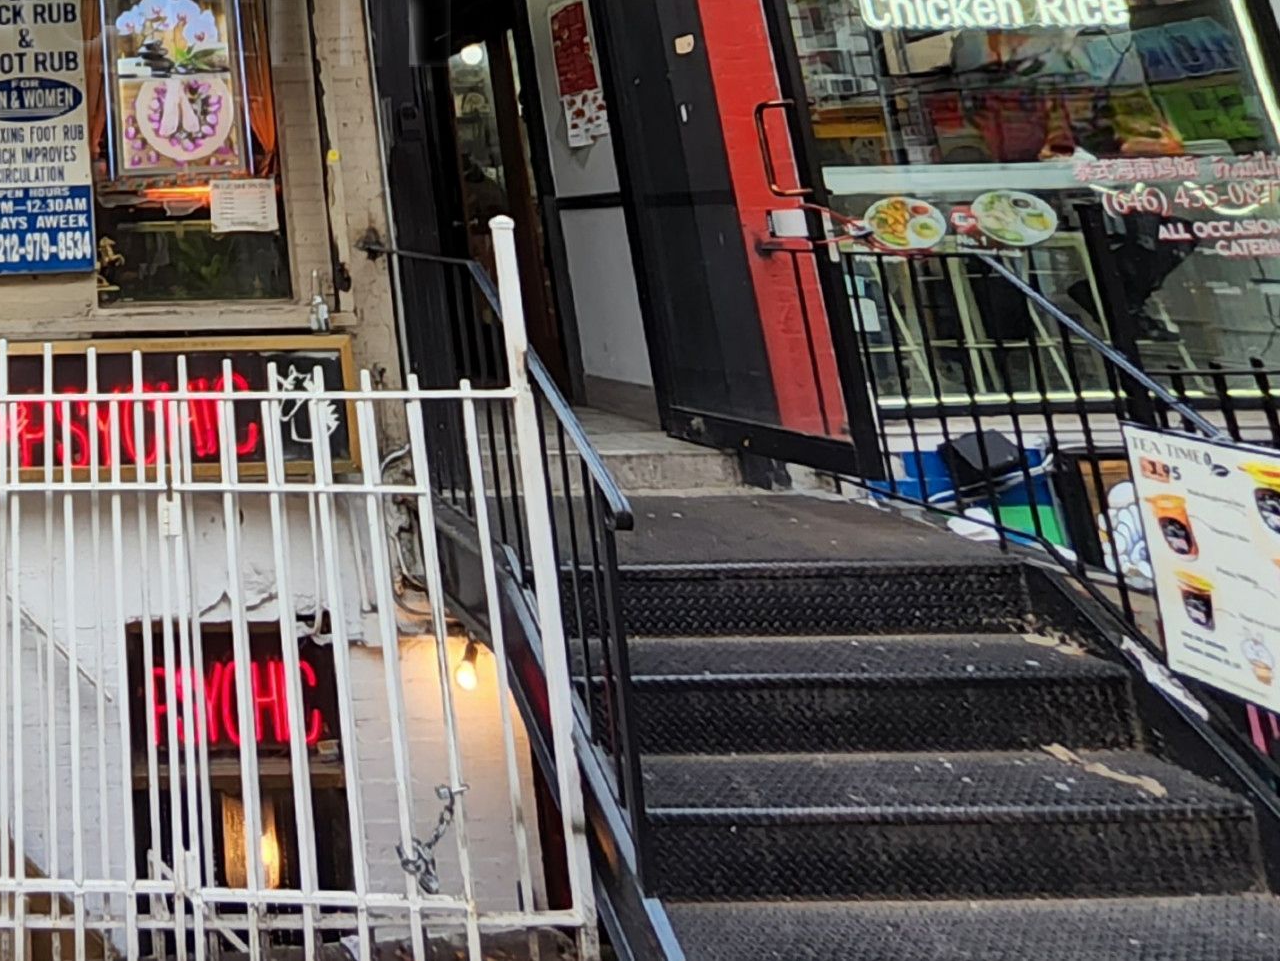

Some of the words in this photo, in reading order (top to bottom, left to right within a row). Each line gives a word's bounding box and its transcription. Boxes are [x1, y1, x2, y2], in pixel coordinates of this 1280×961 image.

[33, 3, 77, 24] RUB
[18, 28, 34, 48] &
[34, 51, 79, 73] RUB
[11, 79, 40, 88] FOR
[10, 91, 20, 109] &
[24, 88, 74, 109] WOMEN
[29, 125, 58, 143] FOOT
[63, 124, 85, 140] RUB
[21, 146, 77, 163] IMPROVES
[29, 187, 70, 197] HOURS
[1101, 186, 1169, 218] (646)
[1158, 223, 1193, 240] ALL
[1131, 436, 1162, 456] TEA
[1166, 443, 1204, 465] TIME
[151, 659, 323, 747] PSYCHIC
